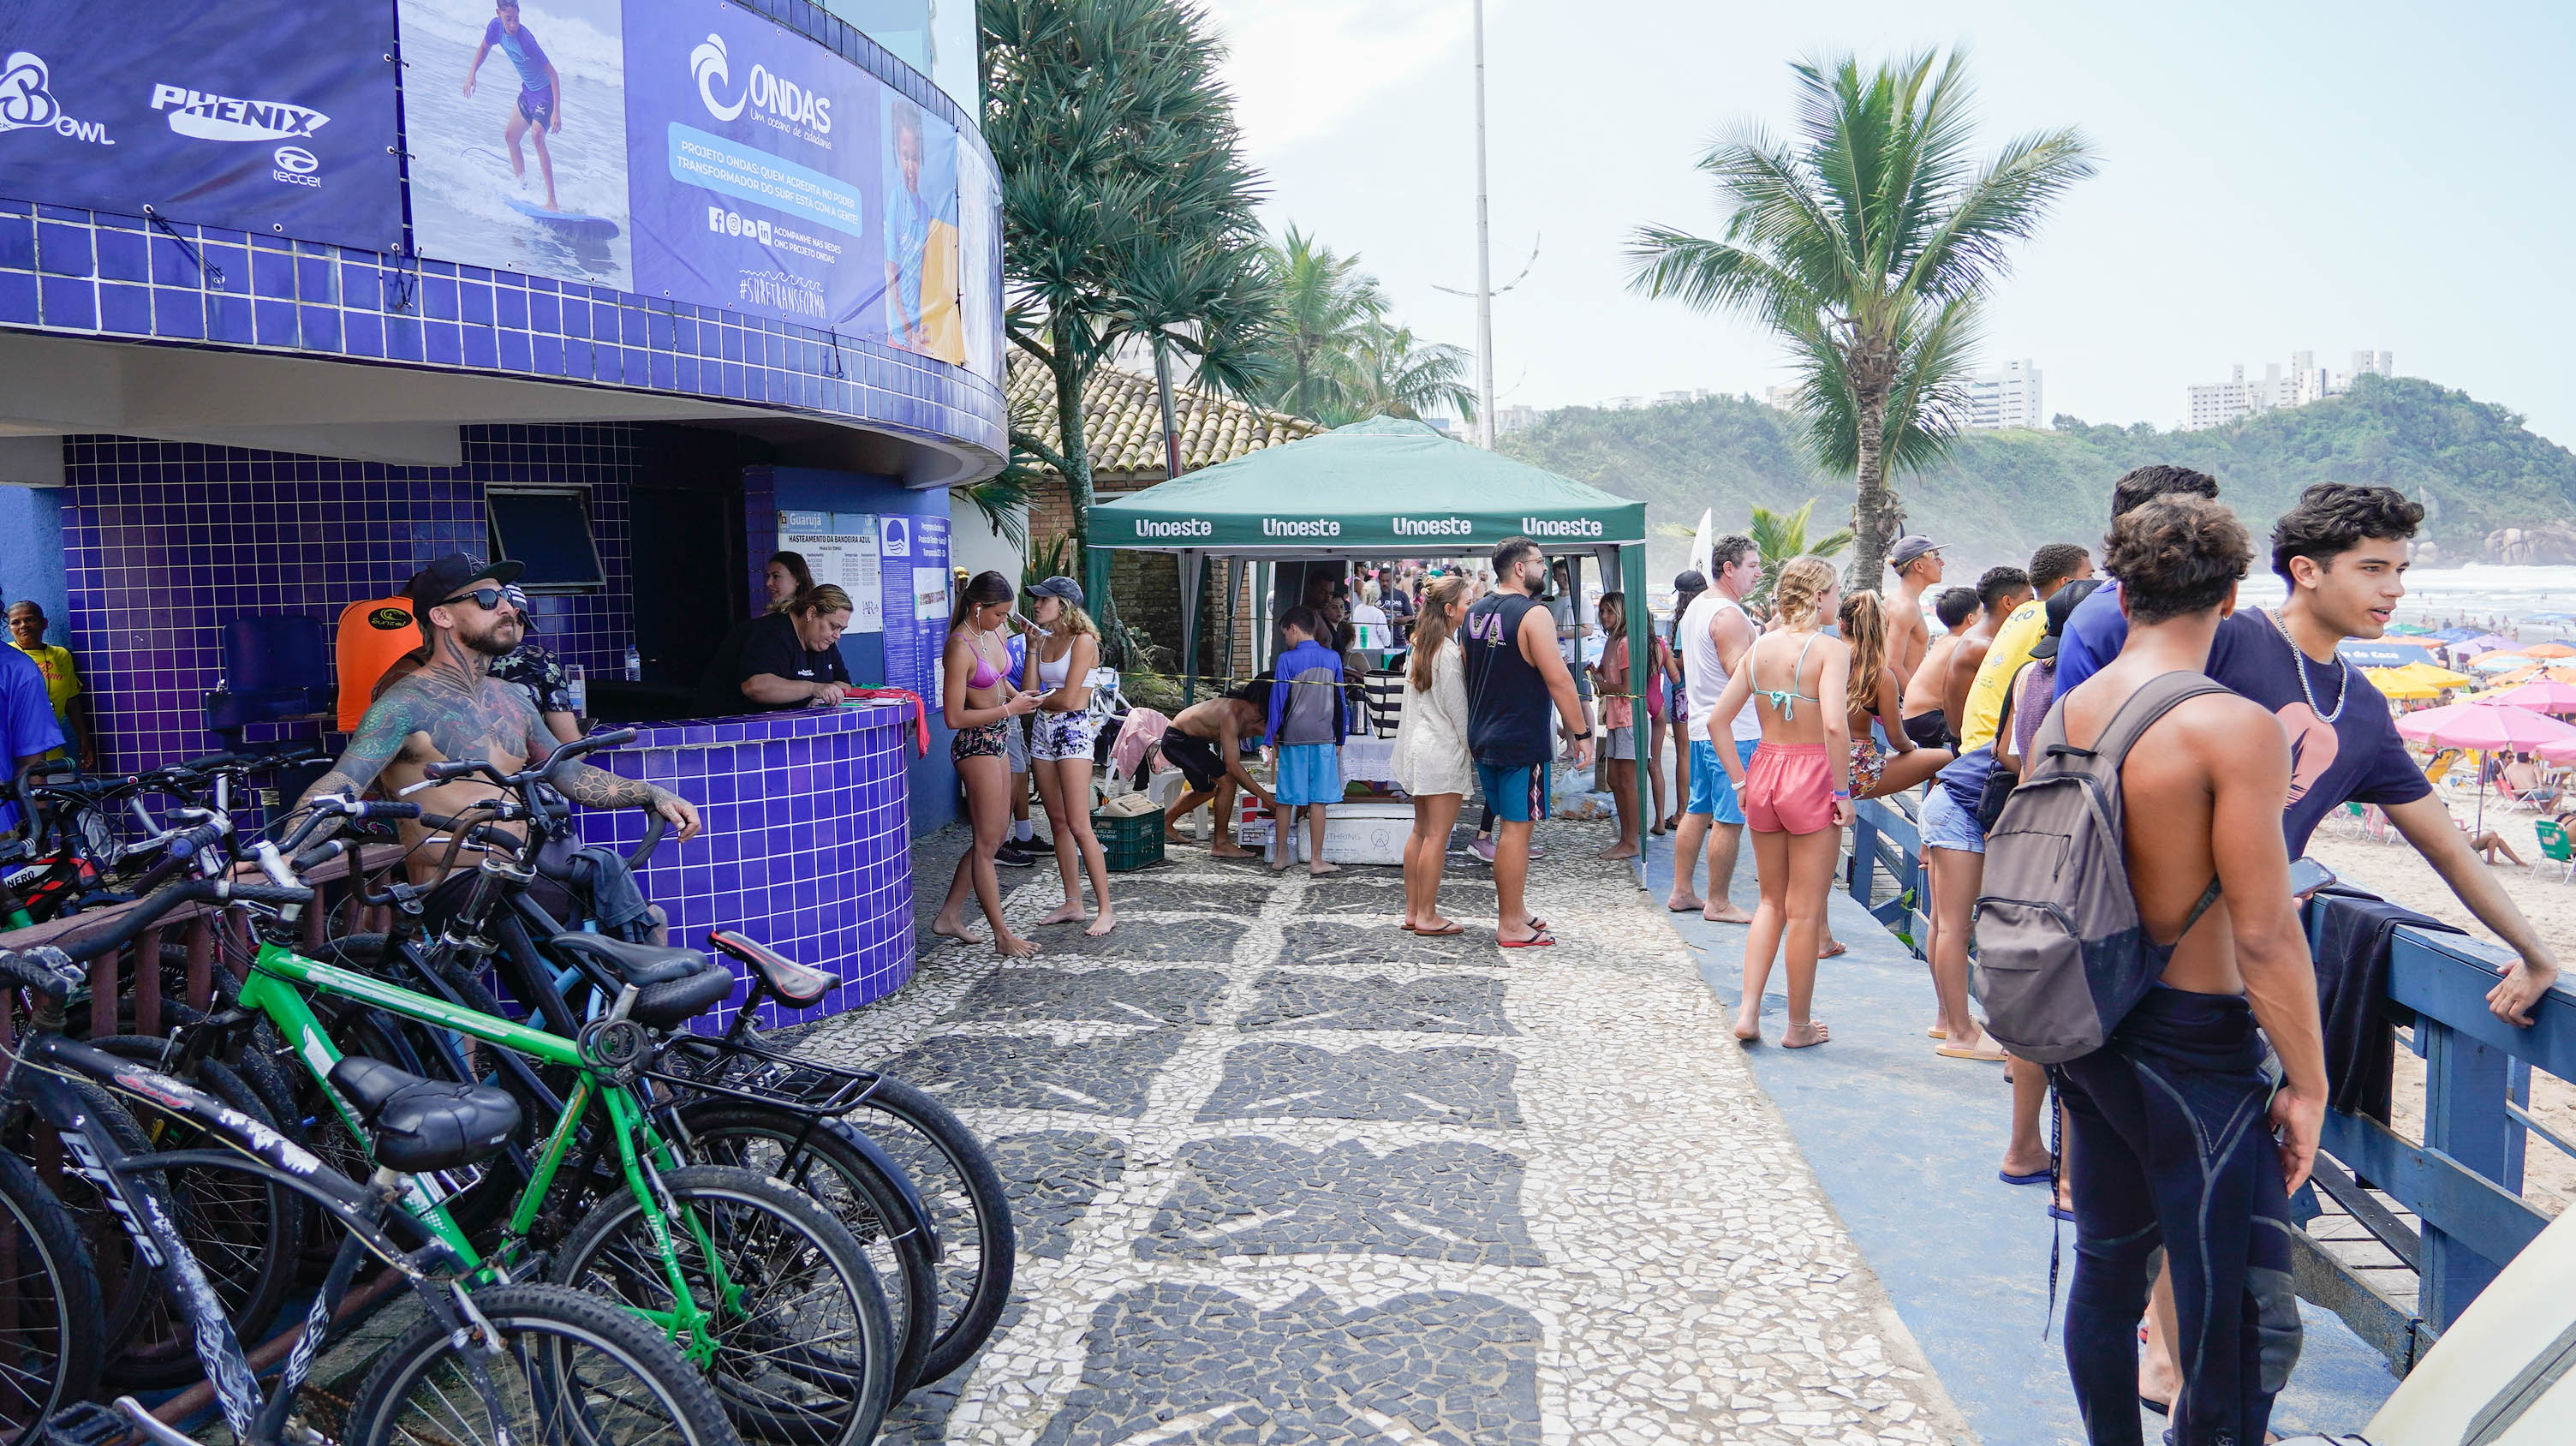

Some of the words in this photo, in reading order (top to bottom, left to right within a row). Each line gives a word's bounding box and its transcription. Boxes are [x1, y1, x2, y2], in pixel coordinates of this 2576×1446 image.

[151, 83, 317, 138] PHENIX
[749, 63, 832, 134] ONDAS
[750, 107, 766, 124] Um
[767, 117, 790, 134] oceano
[792, 123, 802, 138] de
[803, 128, 832, 151] cidadania
[677, 155, 760, 191] TRANSFORMADOR
[760, 182, 774, 195] DO
[775, 186, 795, 202] SURF
[796, 194, 814, 208] ESTÁ
[814, 200, 831, 215] COM
[831, 207, 837, 217] A
[681, 140, 724, 164] PROJETO
[760, 166, 785, 184] QUEM
[786, 176, 821, 197] ACREDITA
[822, 188, 832, 201] NO
[833, 192, 856, 209] PODER
[773, 225, 812, 245] ACOMPANHE
[812, 238, 824, 248] NAS
[824, 242, 842, 254] REDES
[774, 238, 789, 250] ONG
[789, 243, 815, 258] PROJETO
[816, 250, 836, 264] ONDAS
[739, 278, 826, 320] #SURFTRANSFORMA
[790, 512, 821, 529] Guarujá
[1135, 517, 1212, 537] Unoeste
[1262, 517, 1340, 536] Unoeste
[1392, 517, 1472, 535] Unoeste
[1522, 517, 1603, 536] Unoeste
[789, 535, 826, 543] HASTEAMENTO
[6, 870, 35, 889] NERO
